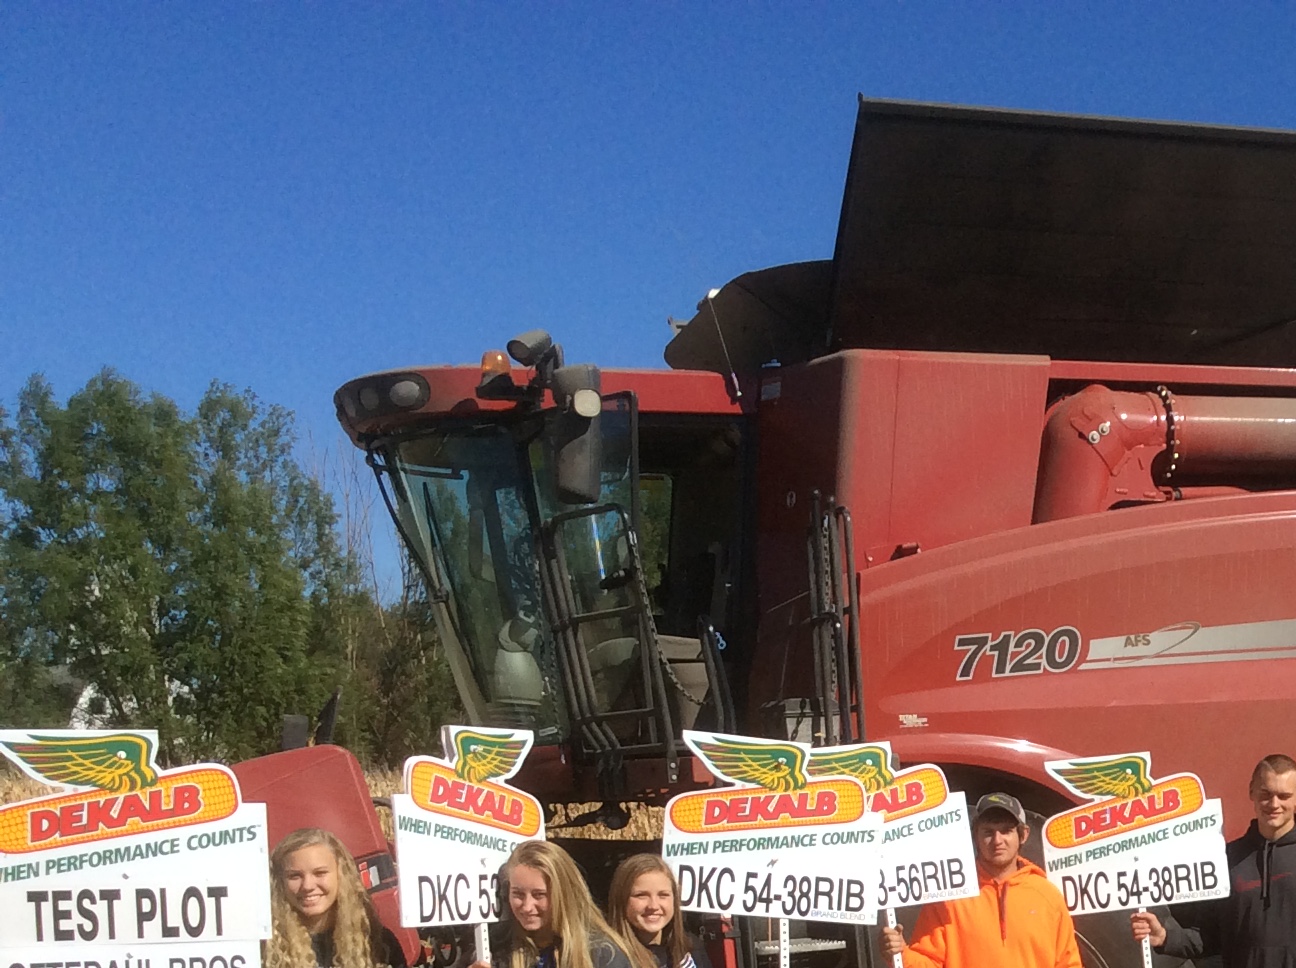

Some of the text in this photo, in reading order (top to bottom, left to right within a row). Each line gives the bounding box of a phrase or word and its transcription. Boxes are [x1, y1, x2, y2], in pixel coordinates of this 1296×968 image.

[954, 625, 1082, 681] 7120
[1123, 633, 1151, 648] AFS
[28, 784, 203, 844] DEKALB
[429, 774, 524, 827] DEKALB
[703, 790, 838, 826] DEKALB
[917, 809, 962, 833] COUNTS
[1073, 788, 1181, 840] DEKALB
[0, 824, 258, 884] HEN PERFORMANCE COUNTS
[398, 814, 432, 836] WHEN
[433, 823, 508, 853] PERFORMANCE
[665, 841, 709, 857] WHEN
[712, 833, 818, 854] PERFORMANCE
[821, 829, 876, 846] COUNTS
[1047, 814, 1217, 873] WHEN PERFORMANCE COUNTS
[418, 873, 472, 923] DKC
[678, 864, 866, 917] DKC 54-38RIB
[1061, 860, 1218, 913] DKC 54-38RIB
[26, 886, 229, 942] TEST PLOT
[810, 910, 866, 921] BRAND BLEND
